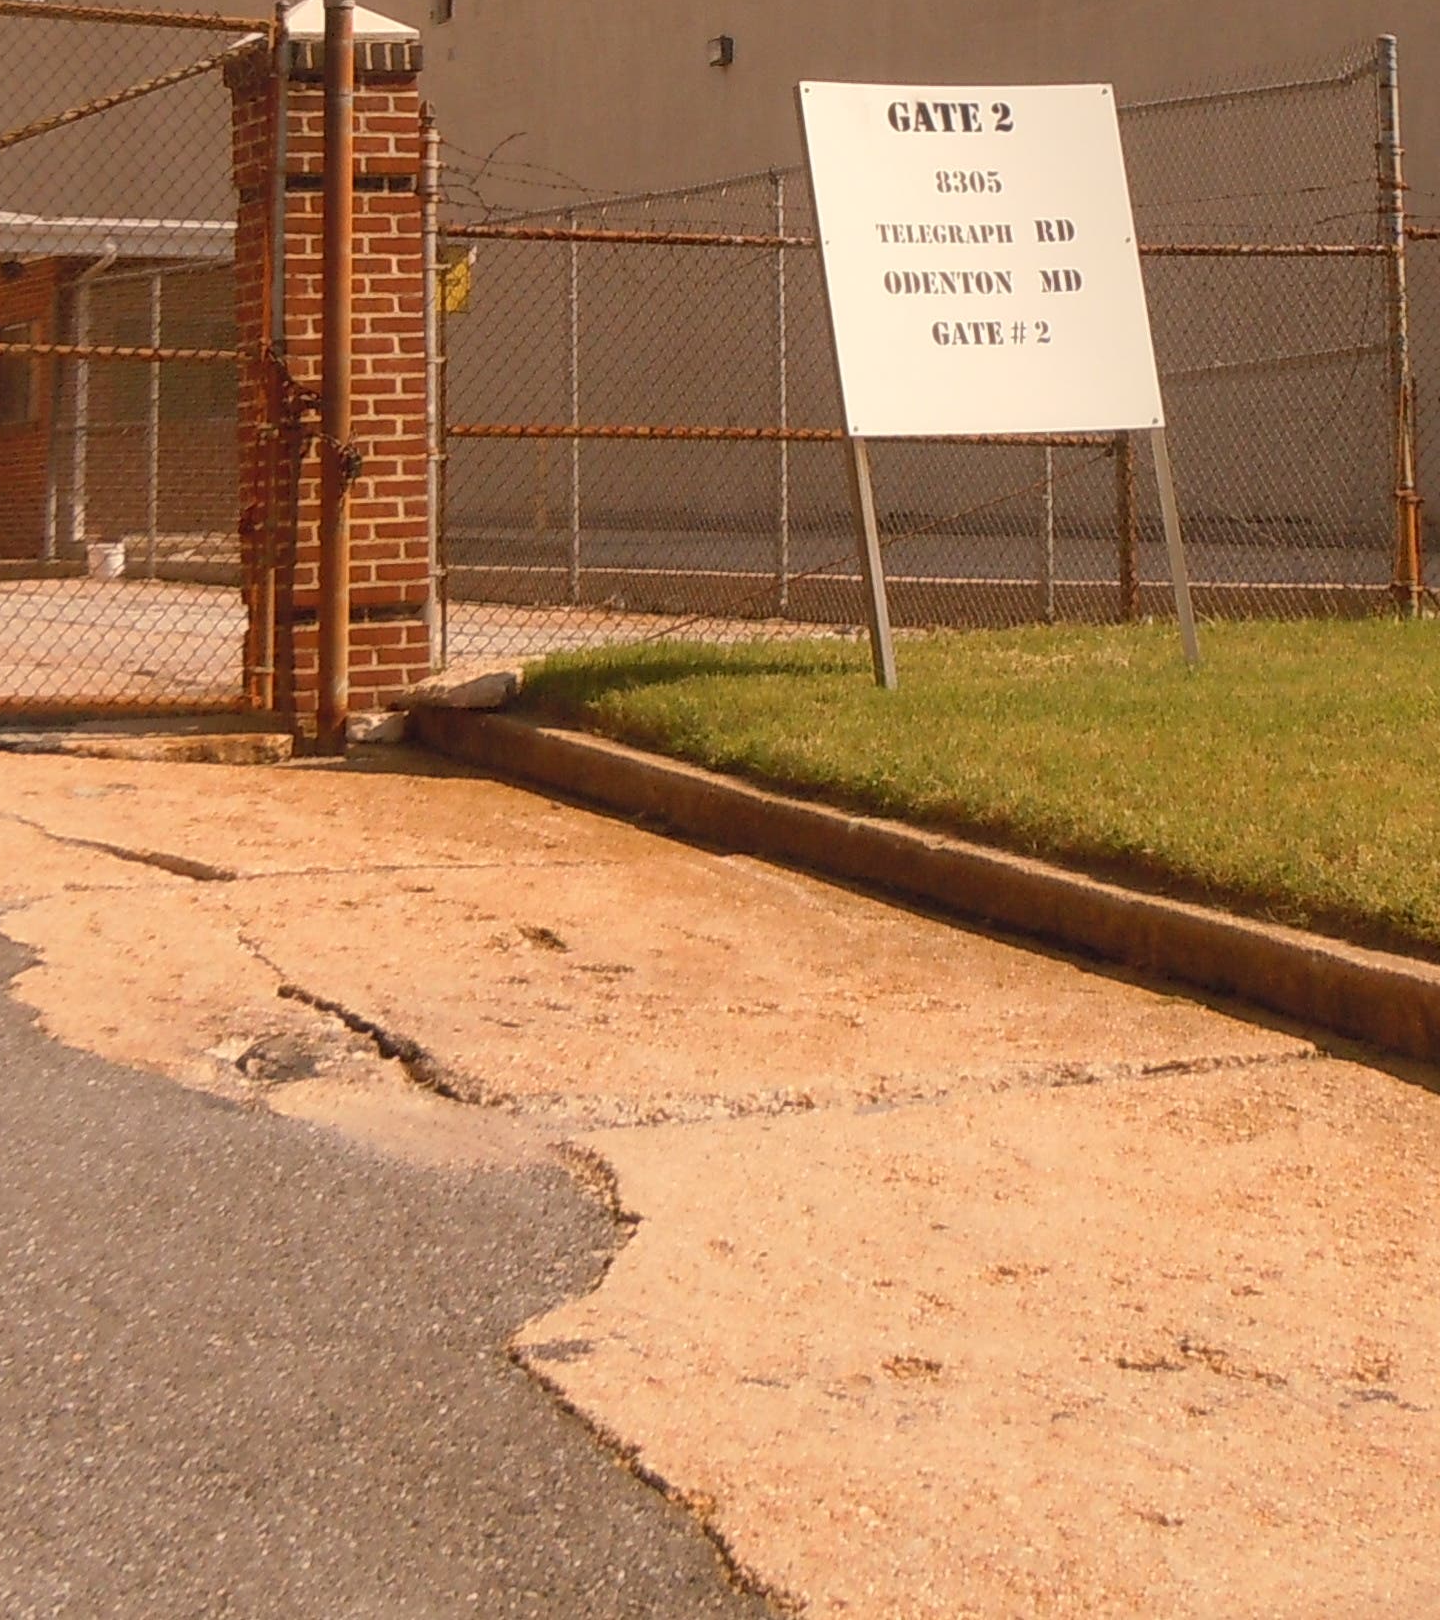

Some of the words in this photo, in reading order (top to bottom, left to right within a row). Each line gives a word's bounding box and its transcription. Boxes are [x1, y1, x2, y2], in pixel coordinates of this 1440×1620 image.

[887, 102, 982, 133] GATE
[992, 102, 1014, 133] 2
[935, 170, 1003, 194] 8305
[875, 224, 1013, 244] TELEGRAPH
[1034, 219, 1075, 243] RD
[884, 270, 1013, 295] ODENTON
[1040, 270, 1082, 293] MD
[932, 322, 1004, 346] GATE
